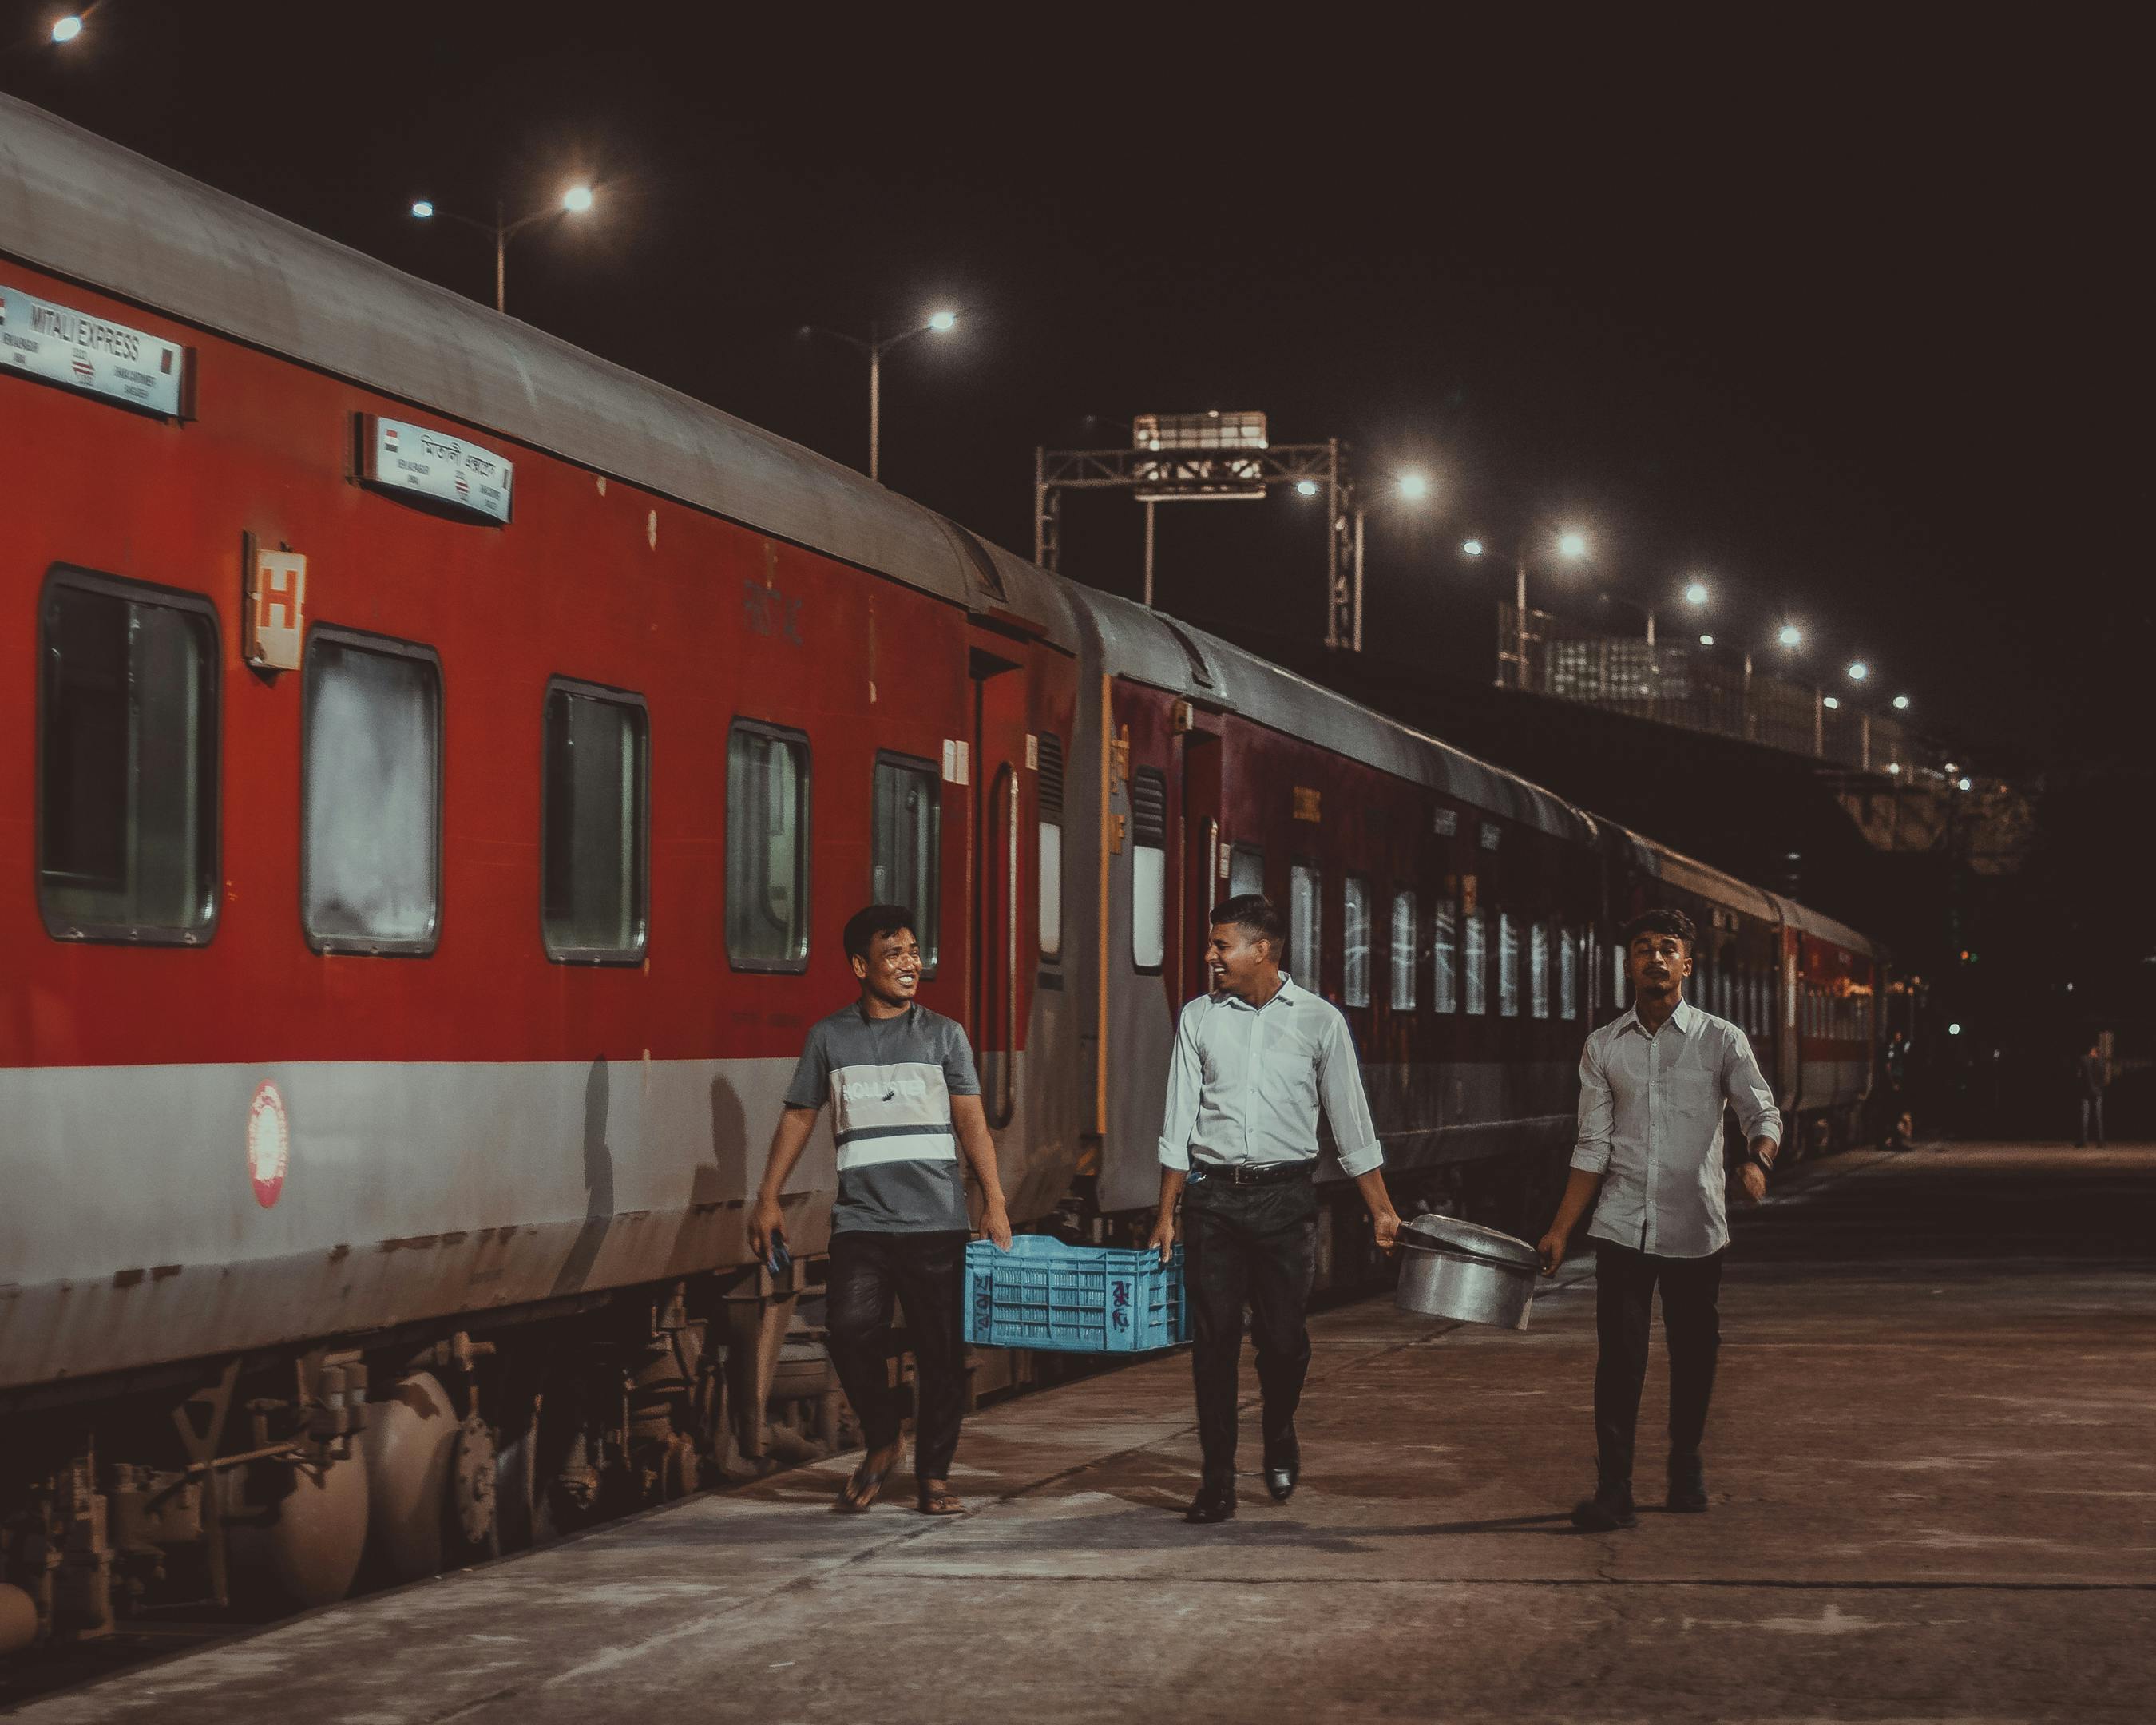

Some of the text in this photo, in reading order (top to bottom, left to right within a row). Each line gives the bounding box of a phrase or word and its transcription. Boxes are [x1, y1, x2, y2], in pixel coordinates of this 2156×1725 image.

[30, 304, 75, 343] MITALI
[78, 319, 140, 362] EXPRESS
[260, 568, 298, 629] H
